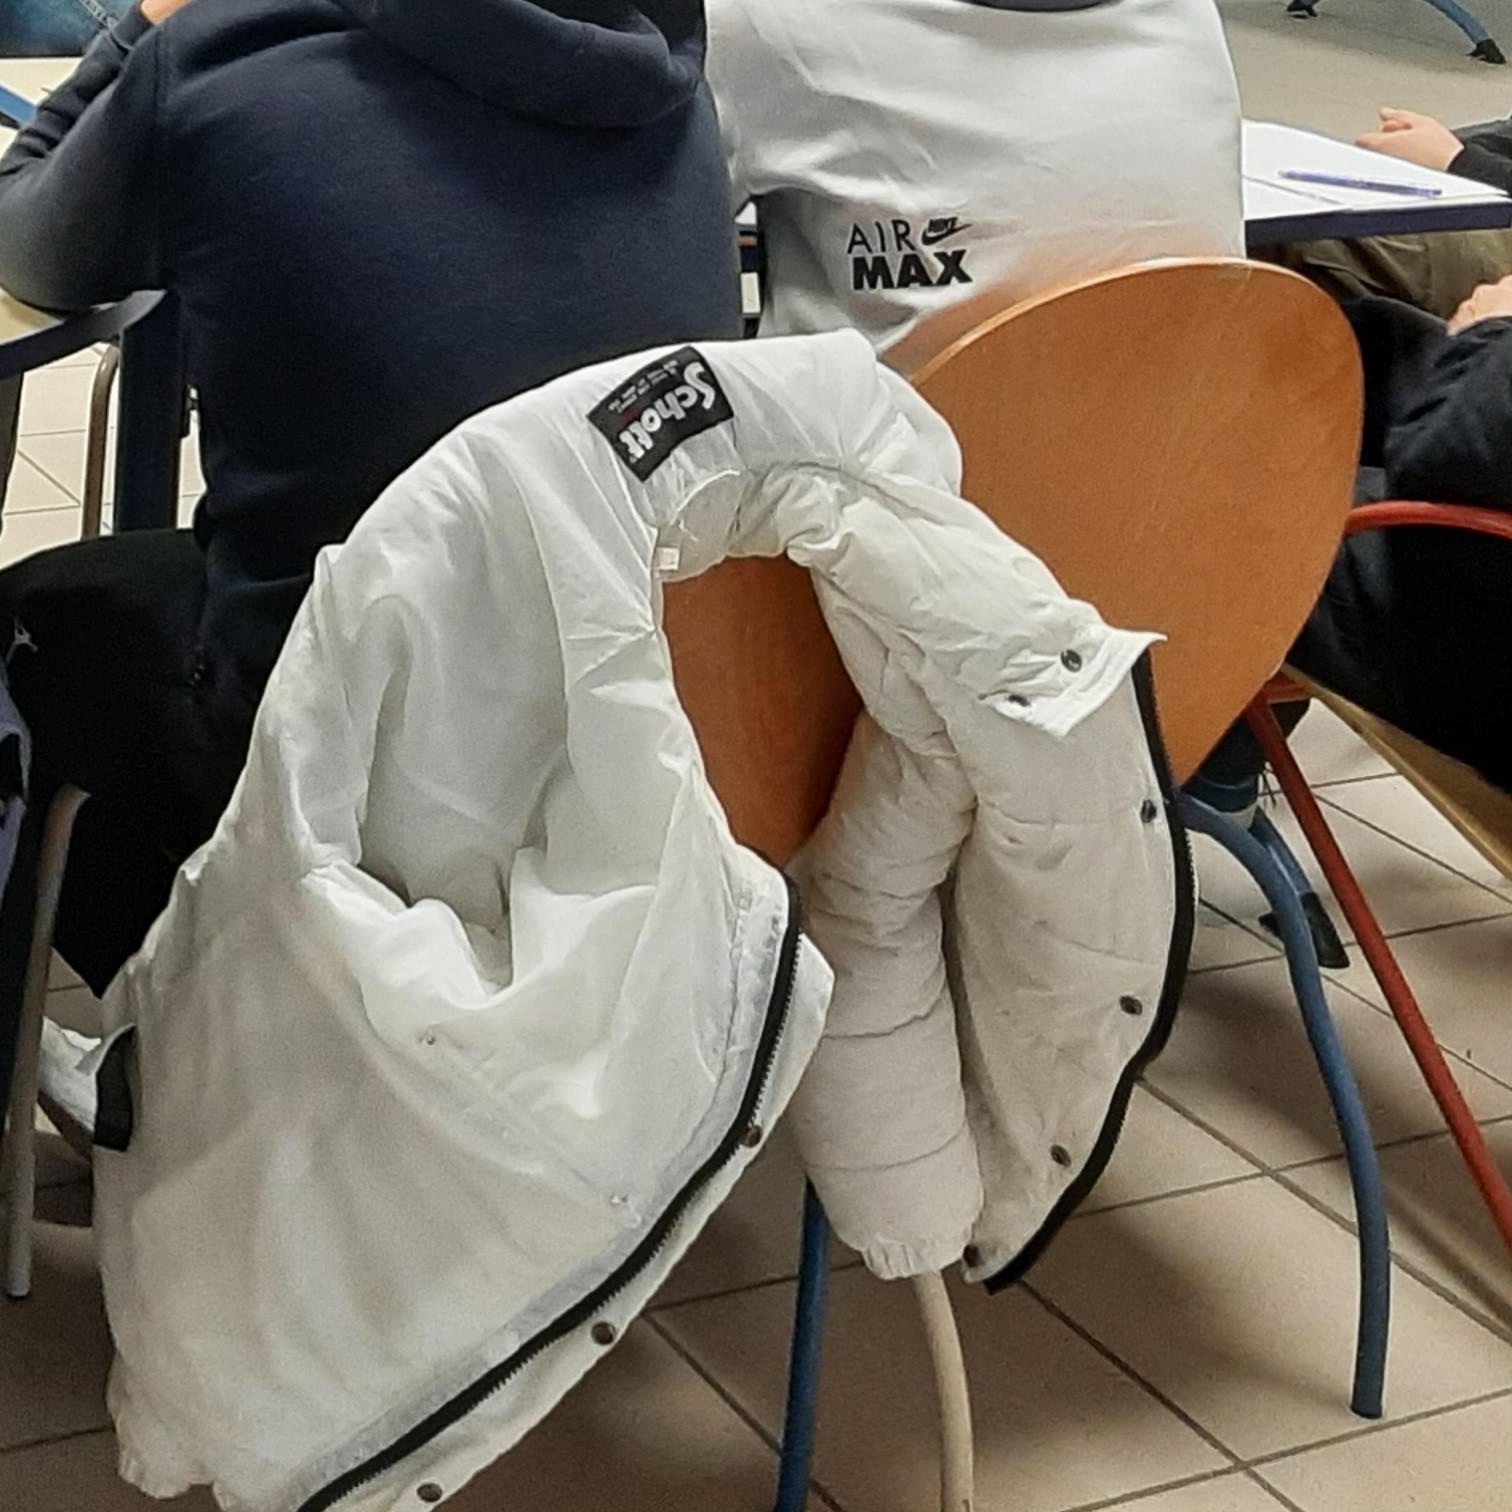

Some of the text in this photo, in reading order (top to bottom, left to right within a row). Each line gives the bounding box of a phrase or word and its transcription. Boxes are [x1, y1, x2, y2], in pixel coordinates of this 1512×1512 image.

[847, 219, 917, 254] AIR
[853, 249, 973, 290] MAX
[618, 361, 716, 458] Schott
